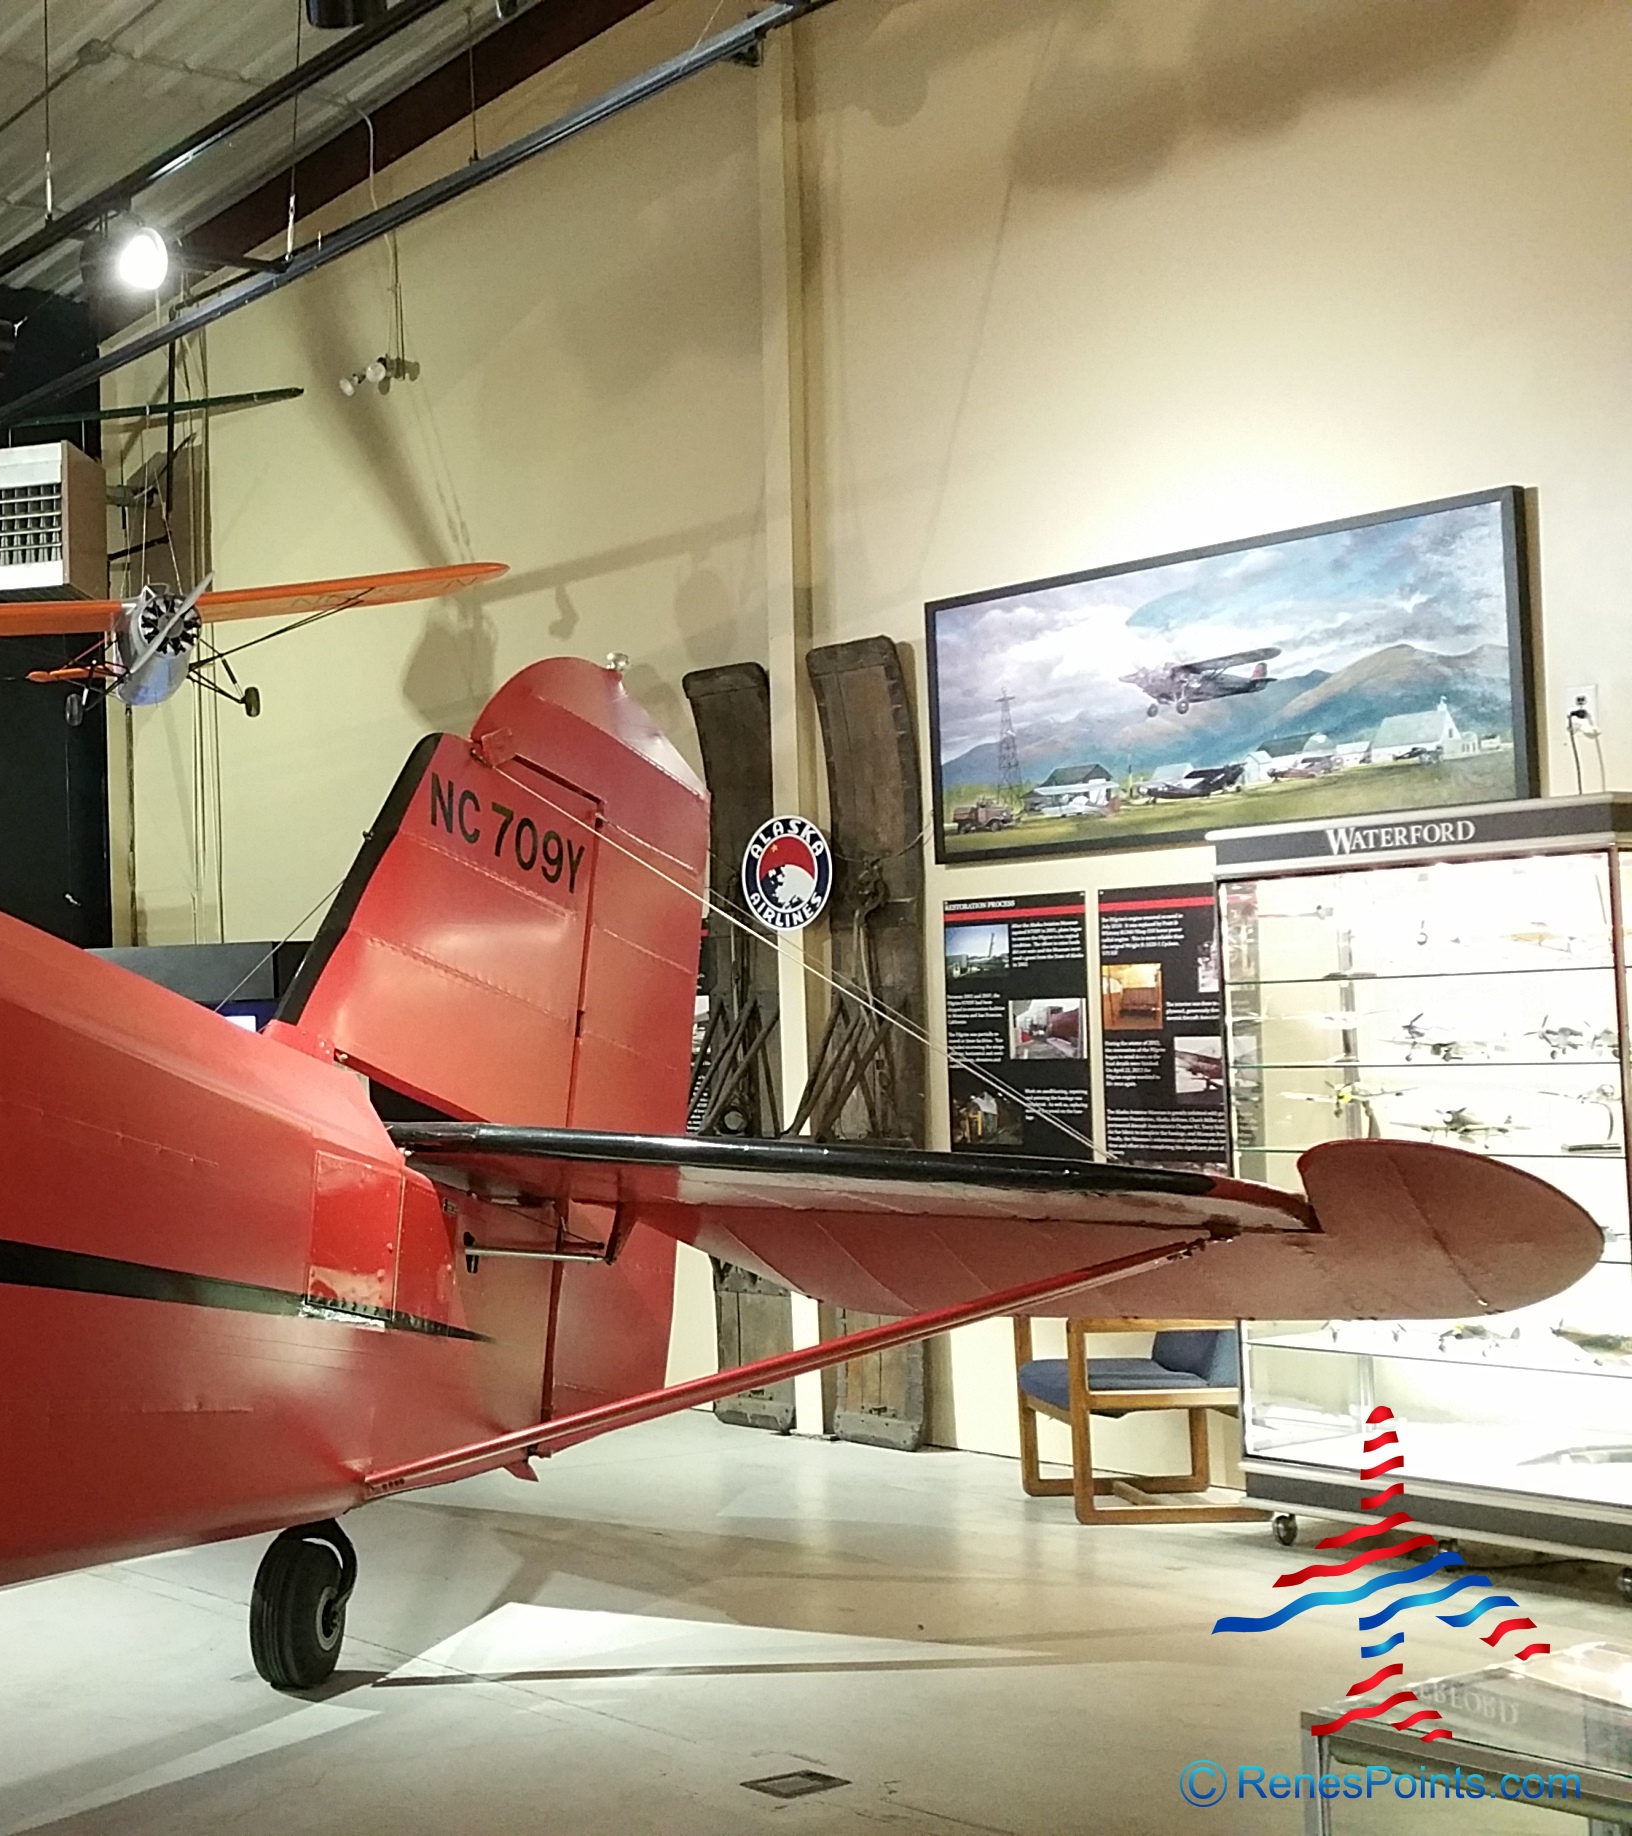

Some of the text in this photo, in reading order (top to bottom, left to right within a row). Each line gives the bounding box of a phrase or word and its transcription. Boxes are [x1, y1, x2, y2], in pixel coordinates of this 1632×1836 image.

[431, 772, 585, 894] NC 709Y
[750, 819, 825, 859] ALASKA
[1326, 820, 1476, 856] WATERFORD
[750, 892, 822, 928] AIRLINES
